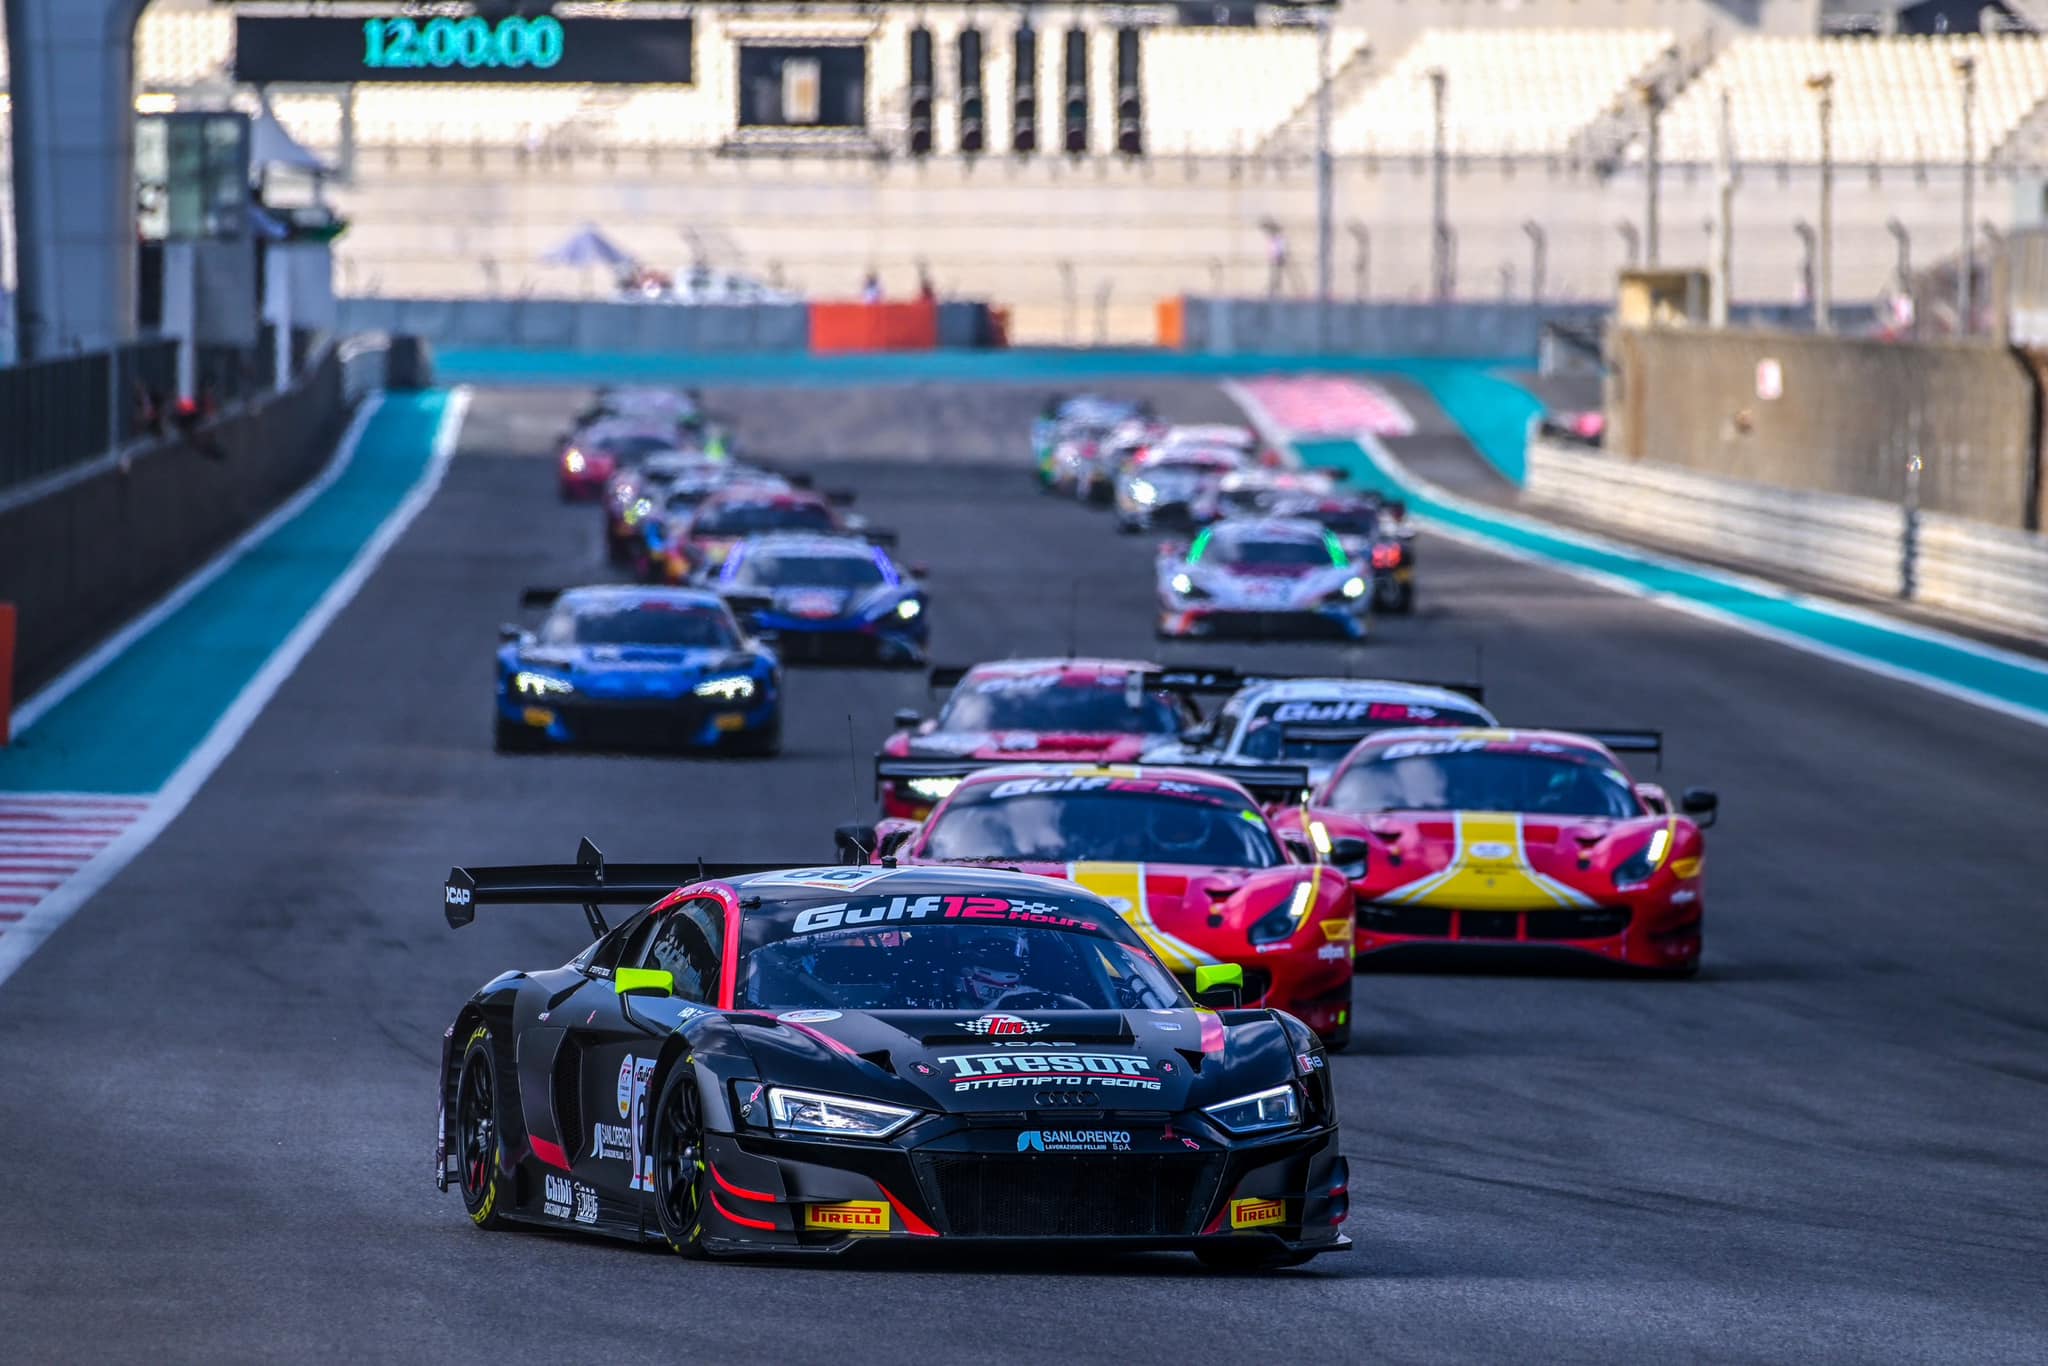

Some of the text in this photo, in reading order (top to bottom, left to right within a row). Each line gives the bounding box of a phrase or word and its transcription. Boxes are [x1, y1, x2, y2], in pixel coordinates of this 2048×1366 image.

[793, 897, 1011, 933] Gulf 12
[938, 1053, 1150, 1077] Tresor
[1043, 1131, 1130, 1143] SANLORENZO
[812, 1206, 882, 1225] PIRELLI
[1236, 1200, 1282, 1223] PIRELLI
